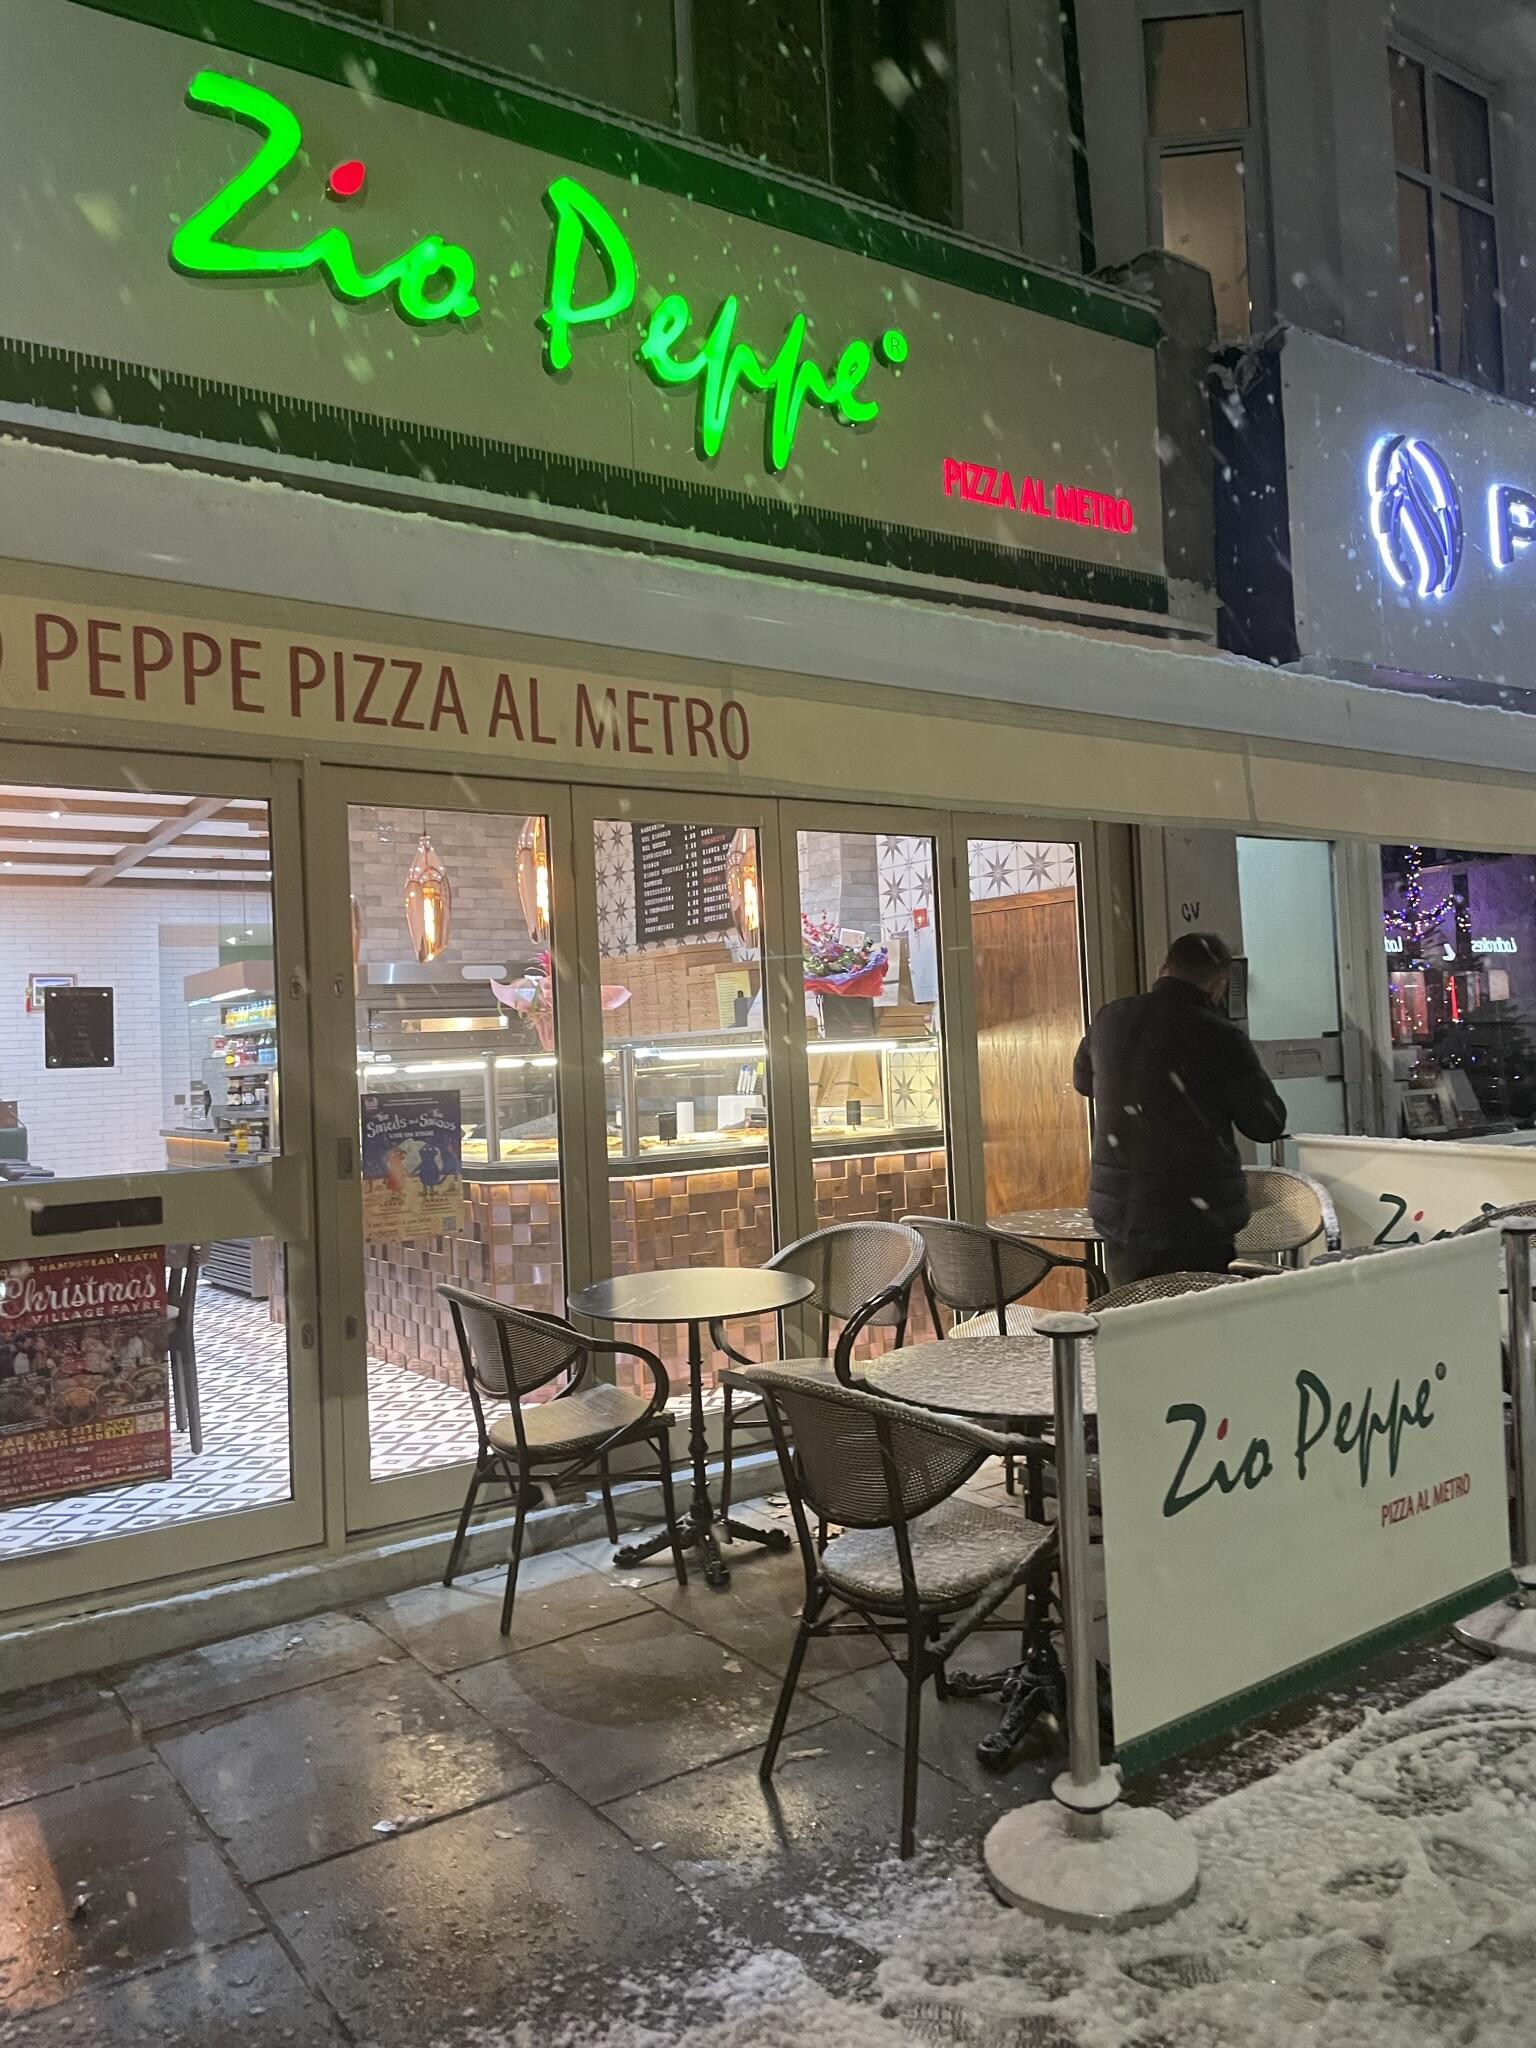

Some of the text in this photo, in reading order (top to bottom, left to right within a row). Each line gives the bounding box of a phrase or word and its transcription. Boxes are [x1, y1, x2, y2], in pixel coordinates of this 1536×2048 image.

[172, 70, 479, 320] Zio
[543, 176, 879, 470] Peppe
[944, 457, 1133, 534] PIZZA AL METRO
[34, 612, 265, 713] PEPPE
[289, 645, 468, 736] PIZZA
[488, 672, 556, 745] AL
[574, 683, 750, 761] METRO
[39, 1257, 115, 1272] HAMPSTEAD
[119, 1252, 158, 1264] HEATH
[0, 1273, 157, 1320] Christmas
[32, 1307, 105, 1325] VILLAGE
[112, 1300, 161, 1315] FAYRE
[1163, 1370, 1434, 1518] Zio Peppe
[1382, 1473, 1471, 1527] PIZZA AL METRO
